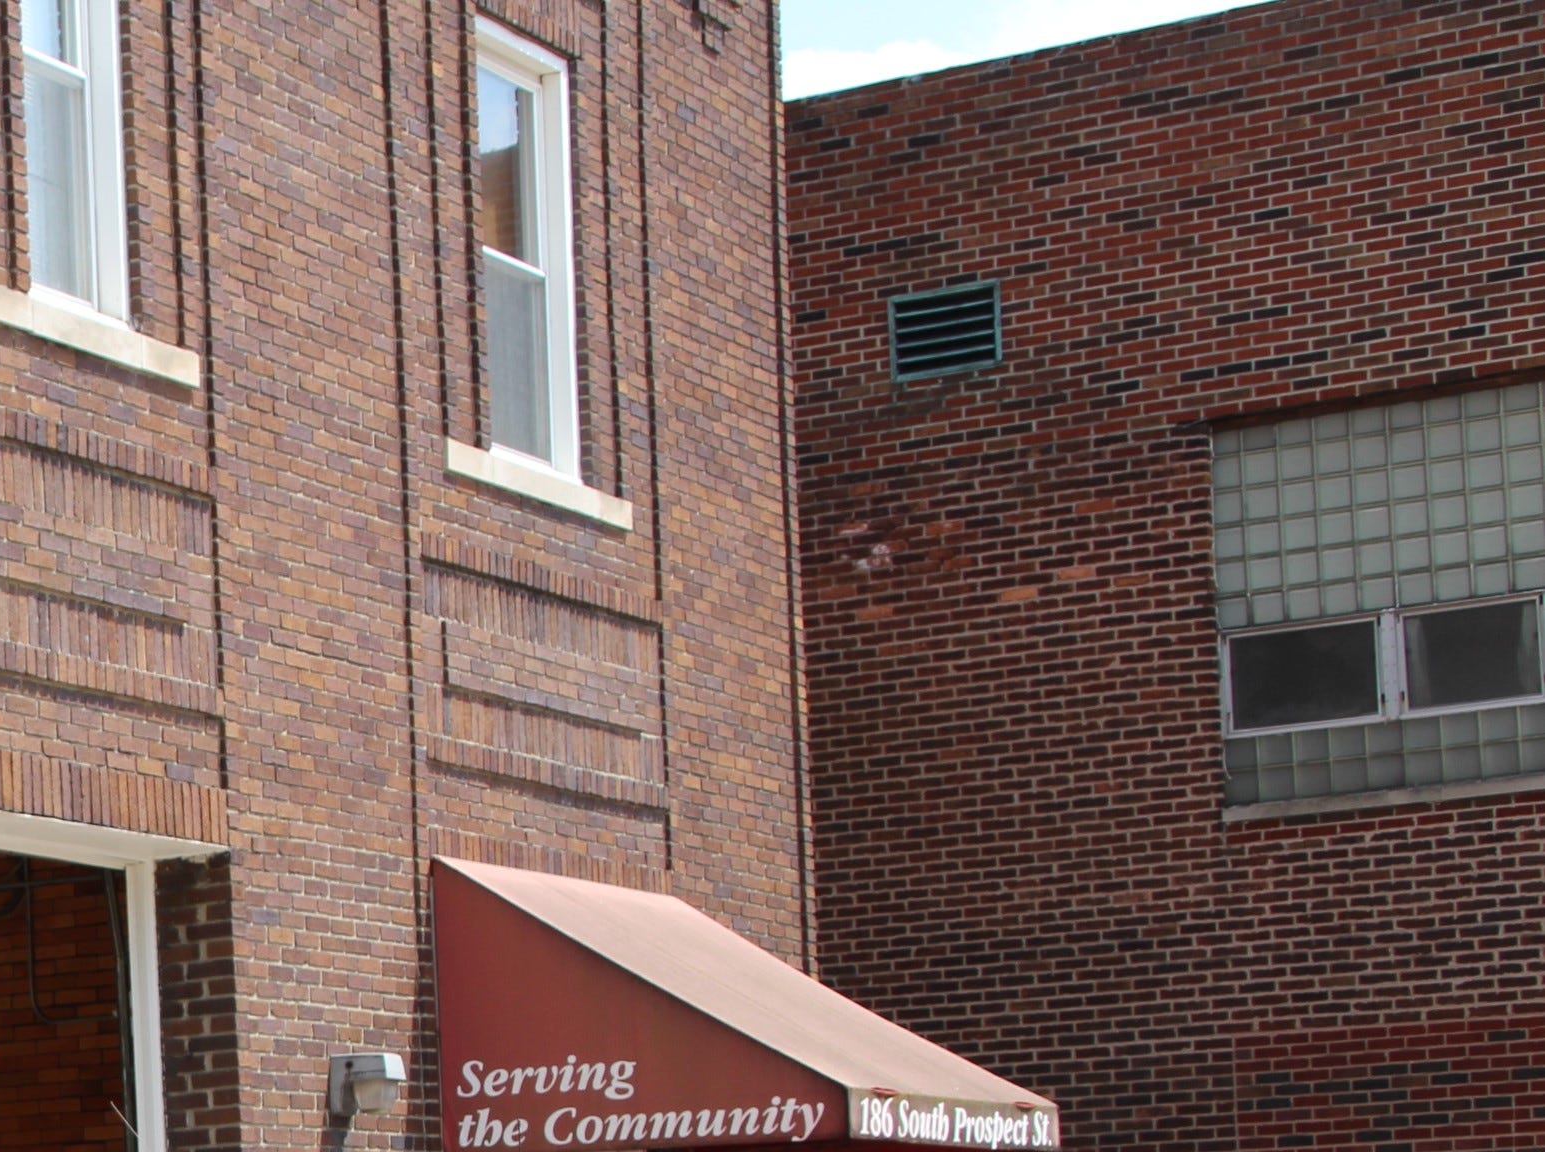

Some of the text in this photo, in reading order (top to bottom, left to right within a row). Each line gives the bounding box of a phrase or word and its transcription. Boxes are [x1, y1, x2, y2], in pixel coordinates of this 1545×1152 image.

[456, 1054, 637, 1100] Serving
[457, 1095, 825, 1147] the Community
[860, 1097, 1053, 1149] 186 South Prospect St.
